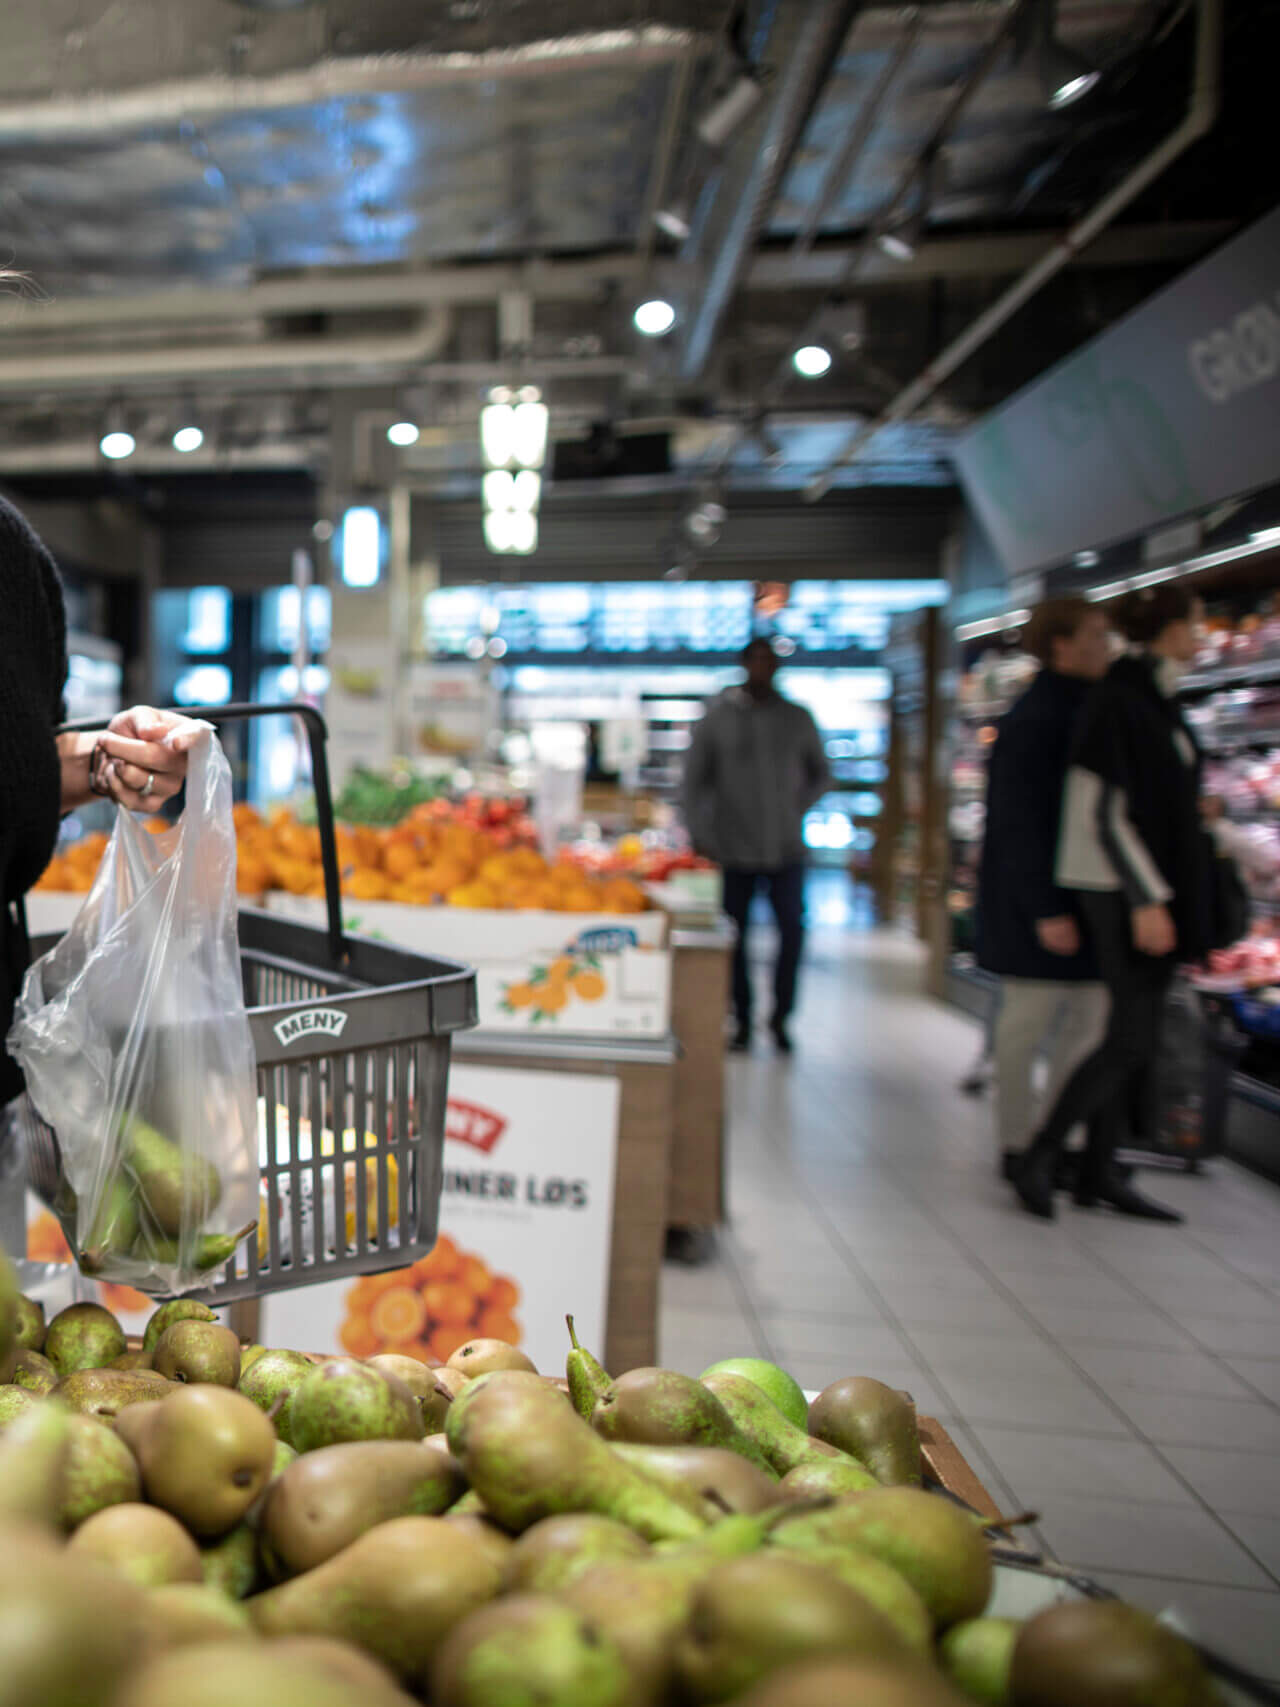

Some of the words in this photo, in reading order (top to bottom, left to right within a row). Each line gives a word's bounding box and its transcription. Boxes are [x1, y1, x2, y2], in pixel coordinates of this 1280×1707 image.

[280, 1012, 342, 1039] MENY
[444, 1168, 516, 1199] INER
[525, 1174, 588, 1209] LØS
